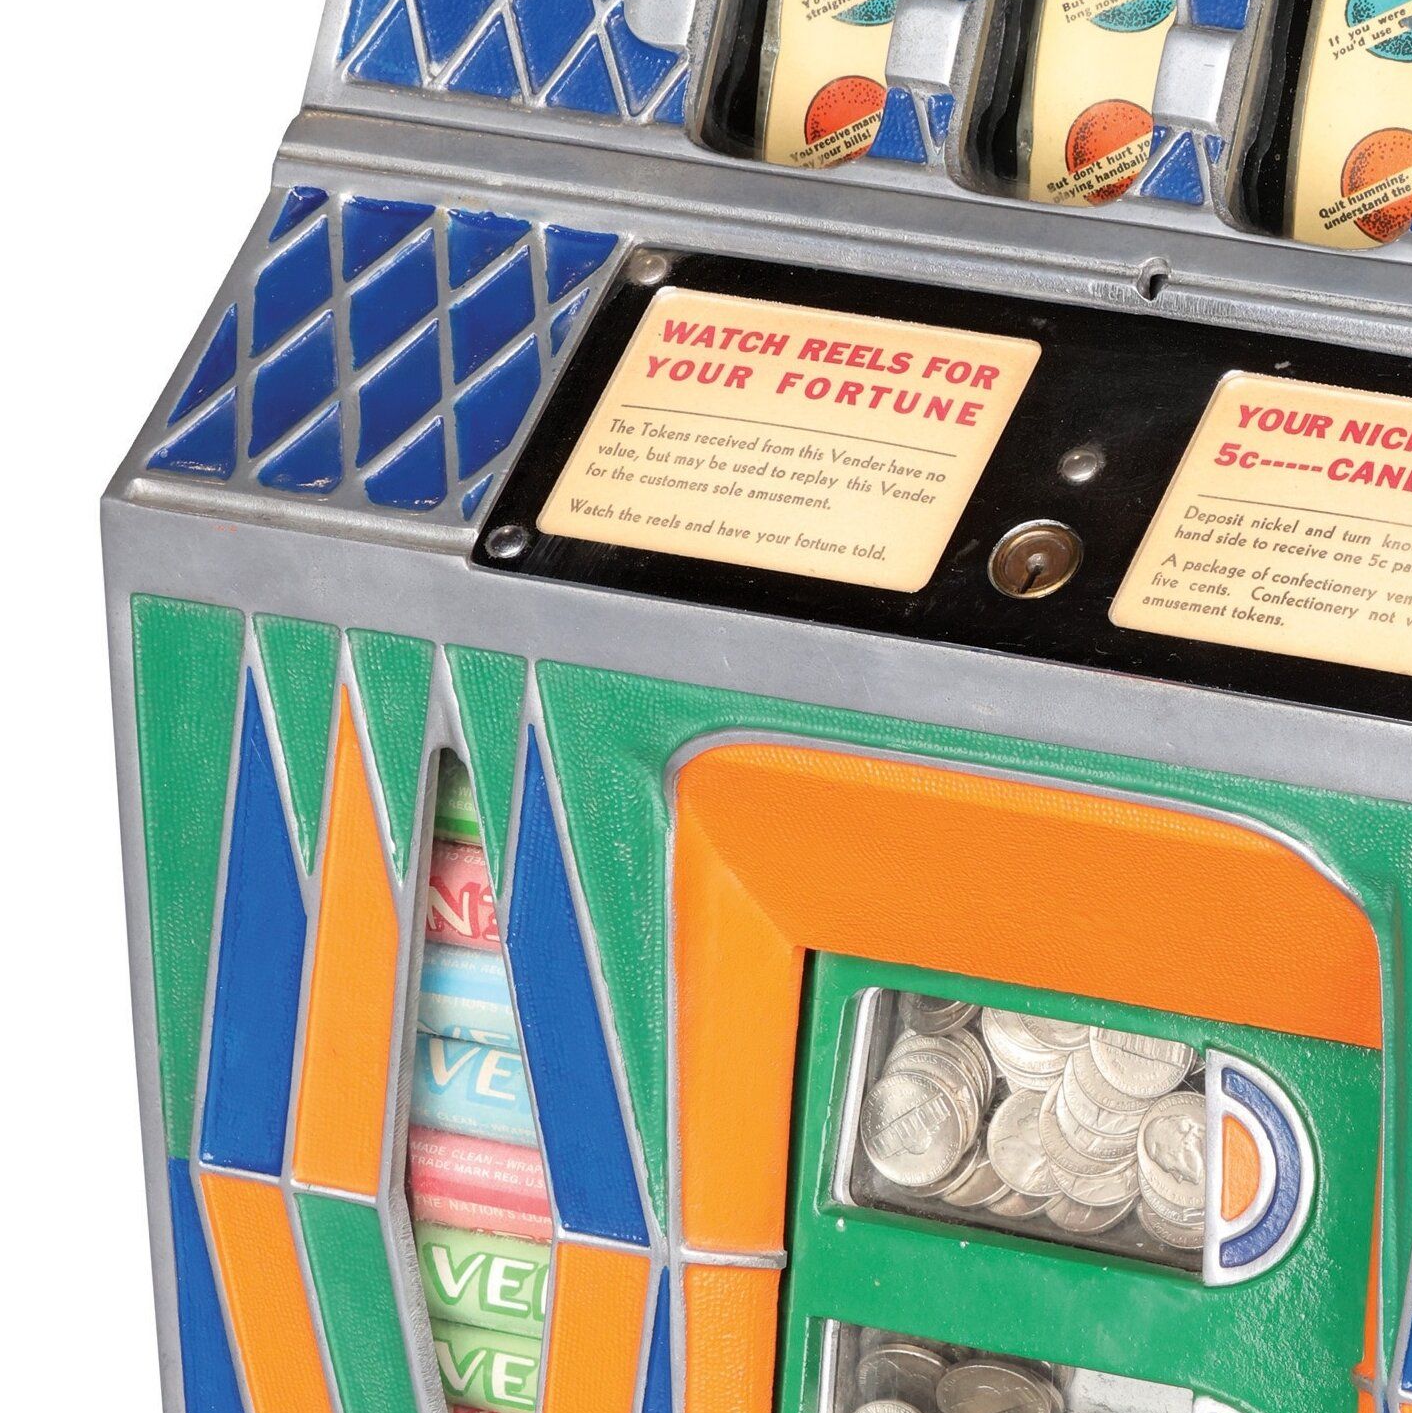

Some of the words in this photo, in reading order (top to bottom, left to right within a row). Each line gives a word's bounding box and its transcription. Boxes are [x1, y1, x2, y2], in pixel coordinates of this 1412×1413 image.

[1065, 7, 1092, 23] long
[1329, 35, 1340, 47] If
[1348, 24, 1370, 41] you
[1378, 8, 1406, 25] were
[1332, 38, 1366, 60] you'd
[1372, 27, 1392, 40] use
[790, 148, 813, 163] You
[814, 130, 851, 153] receive
[852, 111, 881, 132] many
[820, 146, 841, 164] your
[845, 129, 871, 149] bills!
[1046, 177, 1069, 192] But
[1073, 161, 1102, 181] don't
[1106, 146, 1133, 165] hurt
[1052, 181, 1094, 204] playing
[1095, 152, 1148, 183] handball!
[1319, 199, 1347, 219] Quit
[1348, 173, 1409, 206] humming.
[1324, 193, 1389, 230] understand
[1392, 184, 1412, 197] the
[662, 319, 790, 356] WATCH
[798, 338, 913, 374] REELS
[922, 356, 1000, 390] FOR
[646, 356, 753, 389] YOUR
[776, 373, 984, 426] FORTUNE
[1238, 405, 1333, 439] YOUR
[599, 443, 640, 462] value,
[646, 447, 671, 462] but
[674, 454, 705, 469] may
[709, 455, 727, 470] be
[733, 460, 768, 476] used
[771, 467, 786, 479] to
[791, 470, 838, 488] replay
[847, 477, 872, 492] this
[881, 481, 936, 504] Vender
[610, 419, 635, 435] The
[641, 422, 691, 441] Tokens
[695, 434, 760, 450] received
[762, 439, 795, 456] from
[799, 445, 824, 461] this
[831, 448, 886, 471] Vender
[888, 459, 922, 478] have
[926, 471, 946, 482] no
[585, 462, 607, 477] for
[612, 466, 634, 481] the
[640, 474, 709, 492] customers
[713, 482, 743, 497] sole
[748, 489, 831, 510] amusement.
[570, 498, 613, 518] Watch
[619, 508, 642, 523] the
[646, 514, 680, 529] reels
[685, 520, 715, 534] and
[718, 521, 750, 539] have
[757, 532, 790, 545] your
[794, 533, 847, 554] fortune
[853, 544, 886, 561] told.
[1175, 526, 1214, 542] hand
[1216, 533, 1247, 547] side
[1253, 538, 1268, 549] to
[1273, 544, 1328, 559] receive
[1334, 552, 1363, 565] one
[1368, 554, 1388, 568] 5c
[1184, 506, 1244, 526] Deposit
[1251, 518, 1300, 533] nickel
[1305, 526, 1336, 539] and
[1342, 530, 1372, 545] turn
[1151, 572, 1179, 588] five
[1189, 582, 1231, 596] cents.
[1251, 586, 1359, 619] Confectionery
[1369, 611, 1395, 624] not
[1161, 553, 1177, 567] A
[1182, 560, 1246, 578] package
[1252, 567, 1271, 580] of
[1272, 572, 1377, 601] confectionery
[1143, 595, 1227, 617] amusement
[1232, 607, 1285, 626] tokens.
[410, 1141, 445, 1155] MADE
[451, 1149, 493, 1164] CLEAN
[411, 1155, 450, 1170] TRADE
[456, 1164, 490, 1178] MARK
[414, 1194, 442, 1208] THE
[449, 1199, 516, 1219] NATION'S
